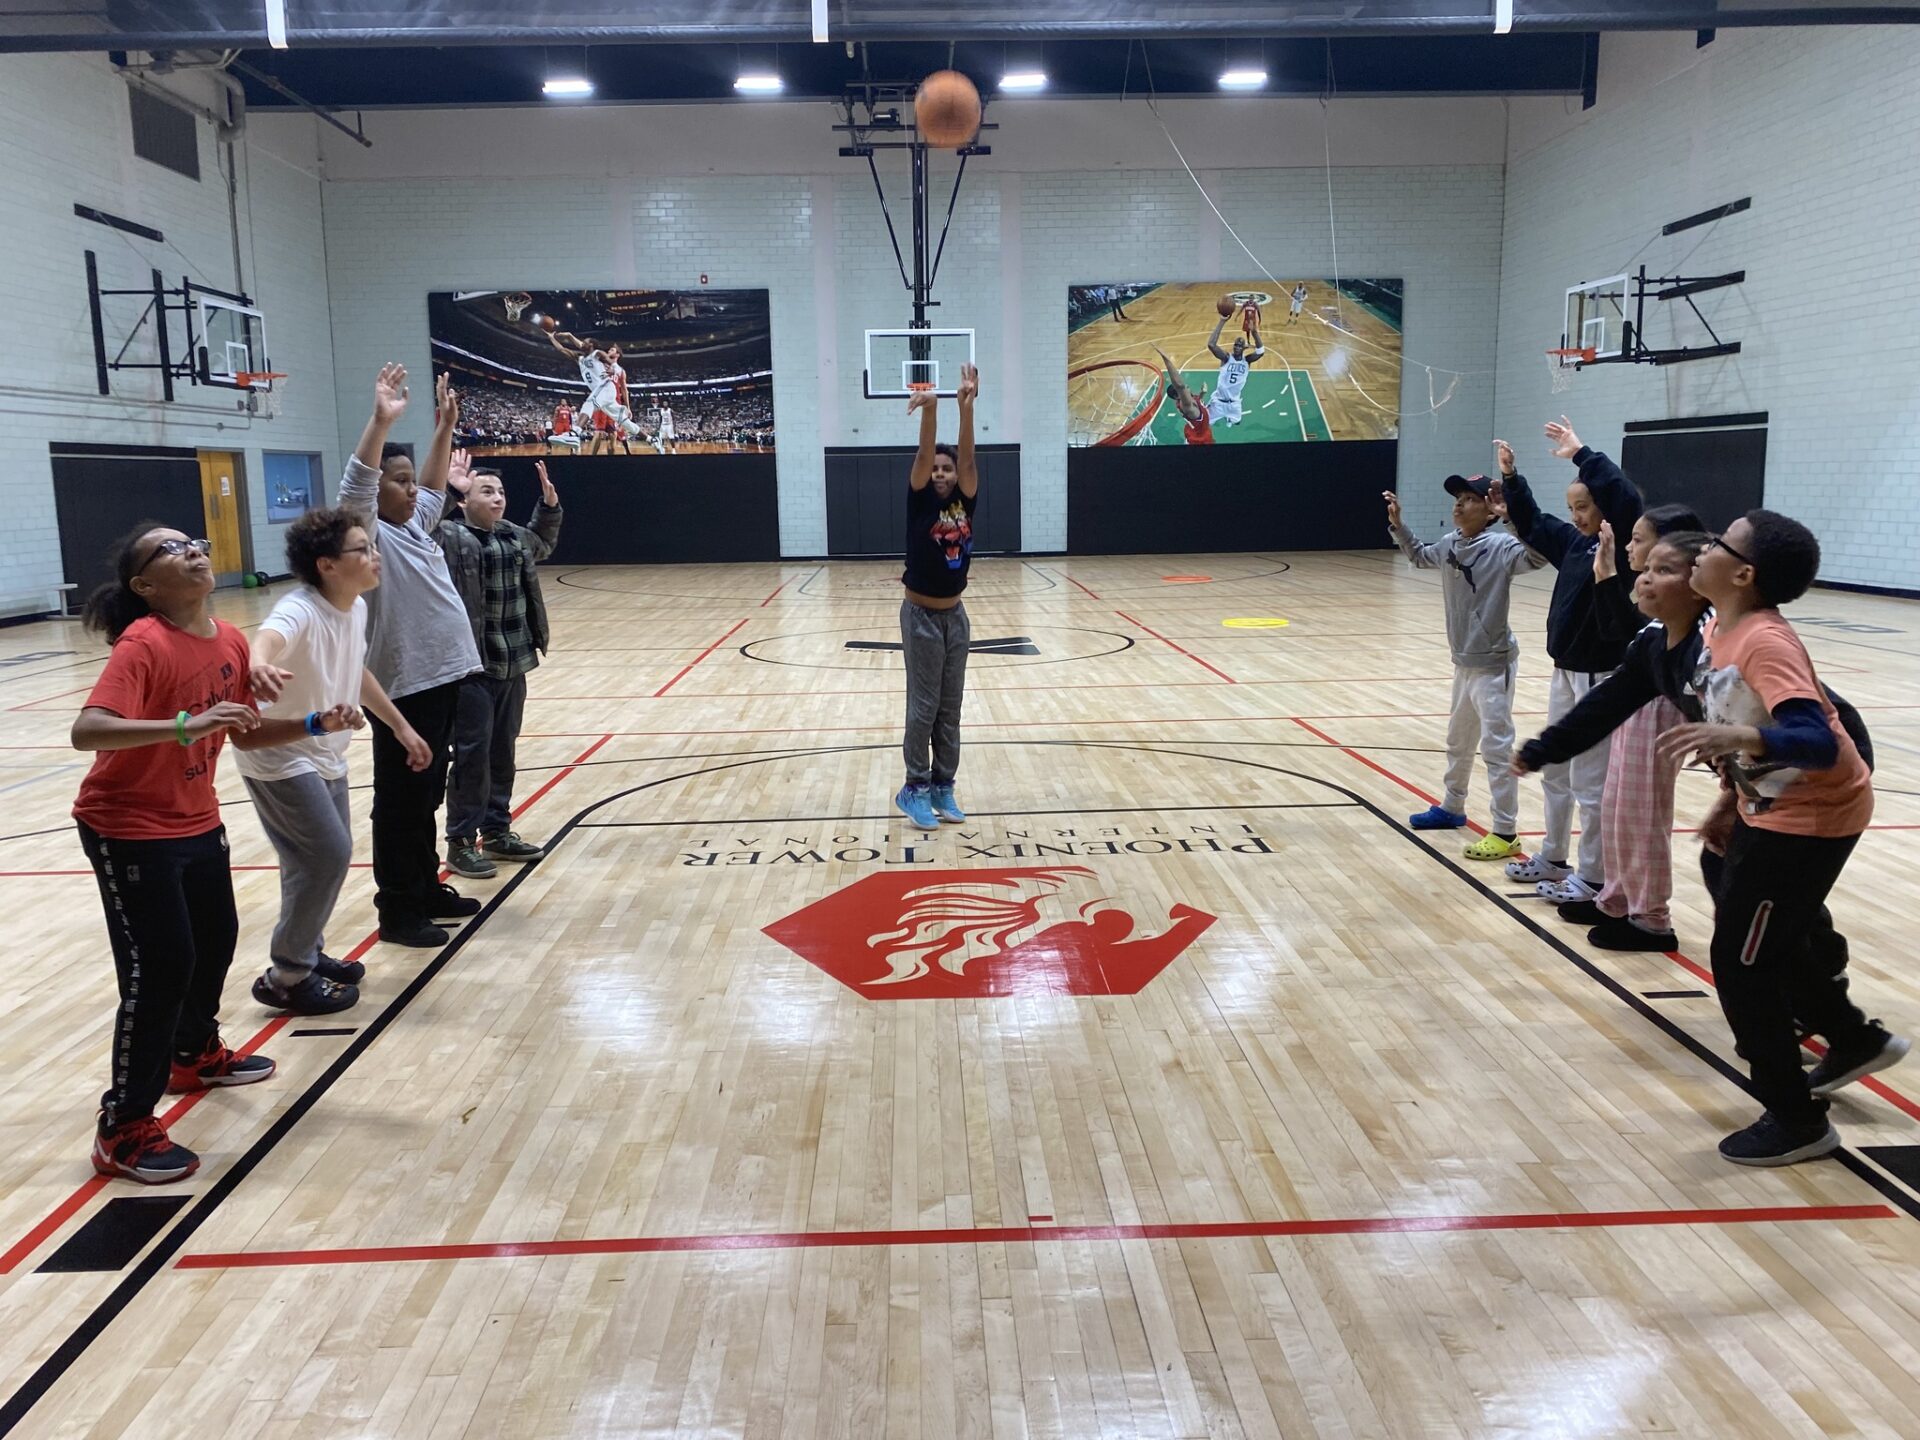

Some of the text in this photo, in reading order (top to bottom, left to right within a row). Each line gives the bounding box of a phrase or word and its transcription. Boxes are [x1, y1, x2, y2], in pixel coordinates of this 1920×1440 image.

[1229, 372, 1239, 384] 5
[690, 824, 1255, 848] INTERNATIONAL
[680, 836, 1281, 867] PHOENIX TOWER
